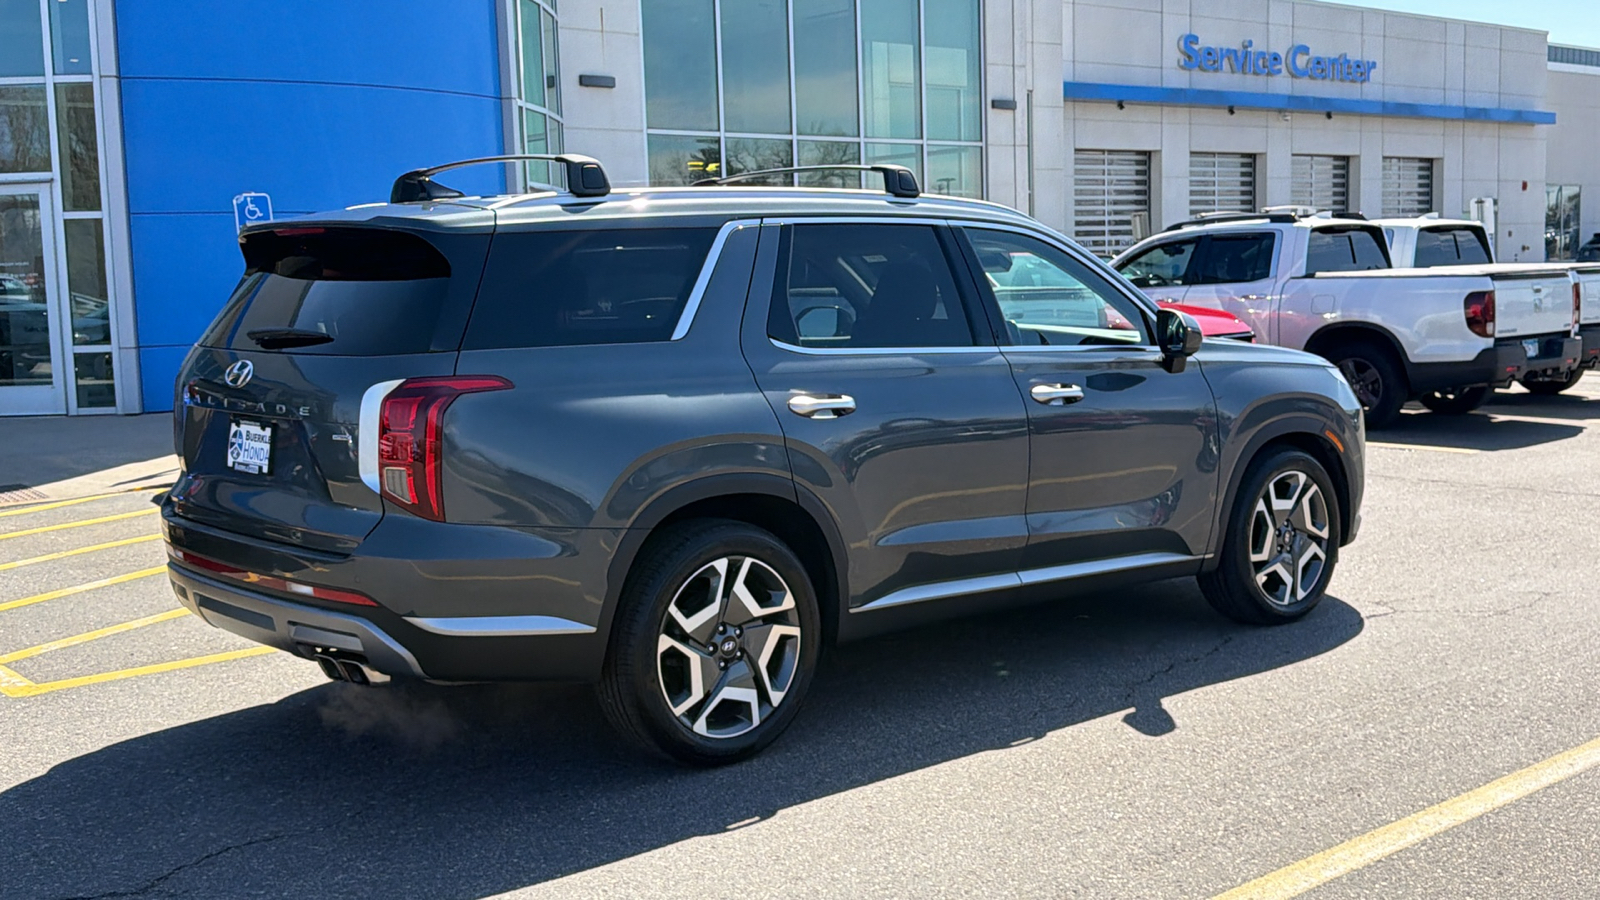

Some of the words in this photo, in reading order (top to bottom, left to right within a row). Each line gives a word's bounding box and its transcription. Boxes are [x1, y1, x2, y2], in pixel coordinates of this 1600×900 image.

[1178, 33, 1283, 75] Service
[1286, 43, 1377, 83] Center
[186, 391, 310, 416] ALISADE
